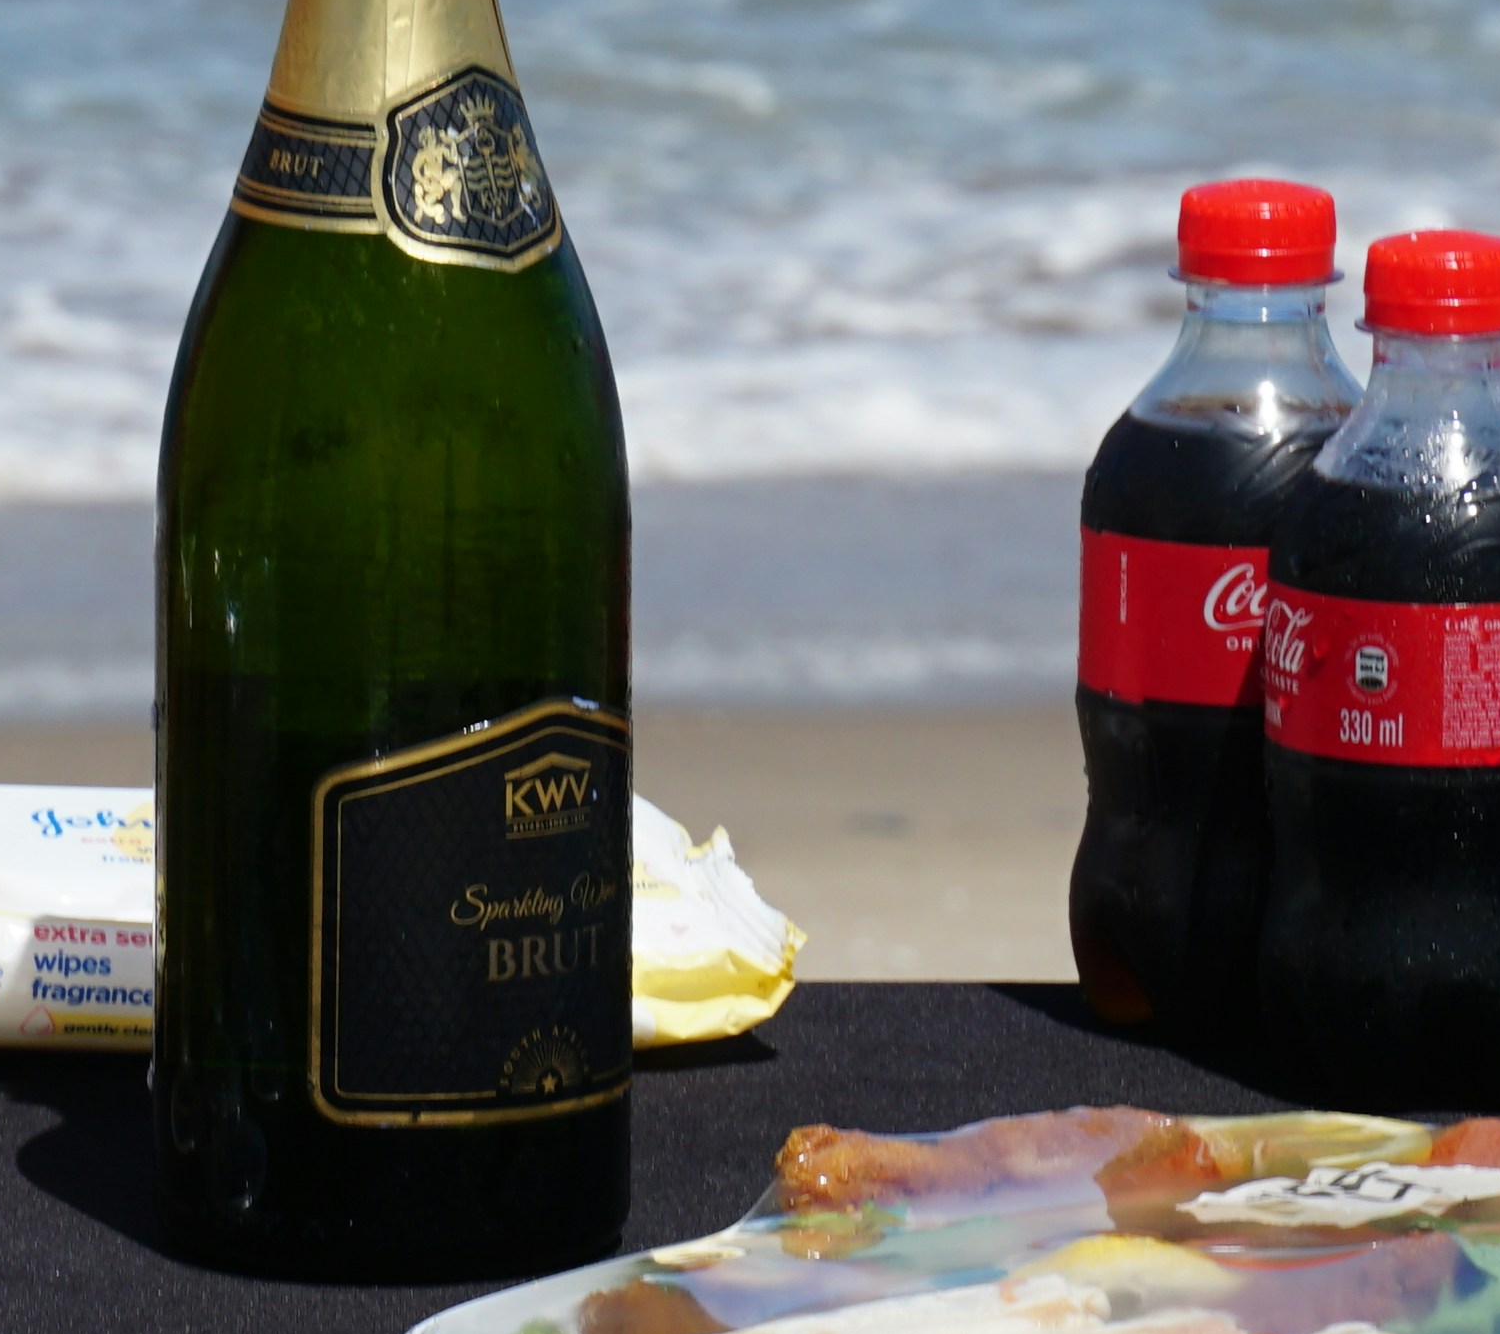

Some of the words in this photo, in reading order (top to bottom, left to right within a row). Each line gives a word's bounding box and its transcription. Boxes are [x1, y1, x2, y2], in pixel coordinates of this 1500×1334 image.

[269, 147, 324, 179] BRUT
[1340, 708, 1372, 746] 330
[1379, 713, 1403, 747] ml
[506, 774, 590, 820] KWV
[450, 883, 564, 930] Sparkling
[34, 924, 106, 946] extra
[487, 923, 604, 982] BRUT
[34, 948, 111, 978] wipes
